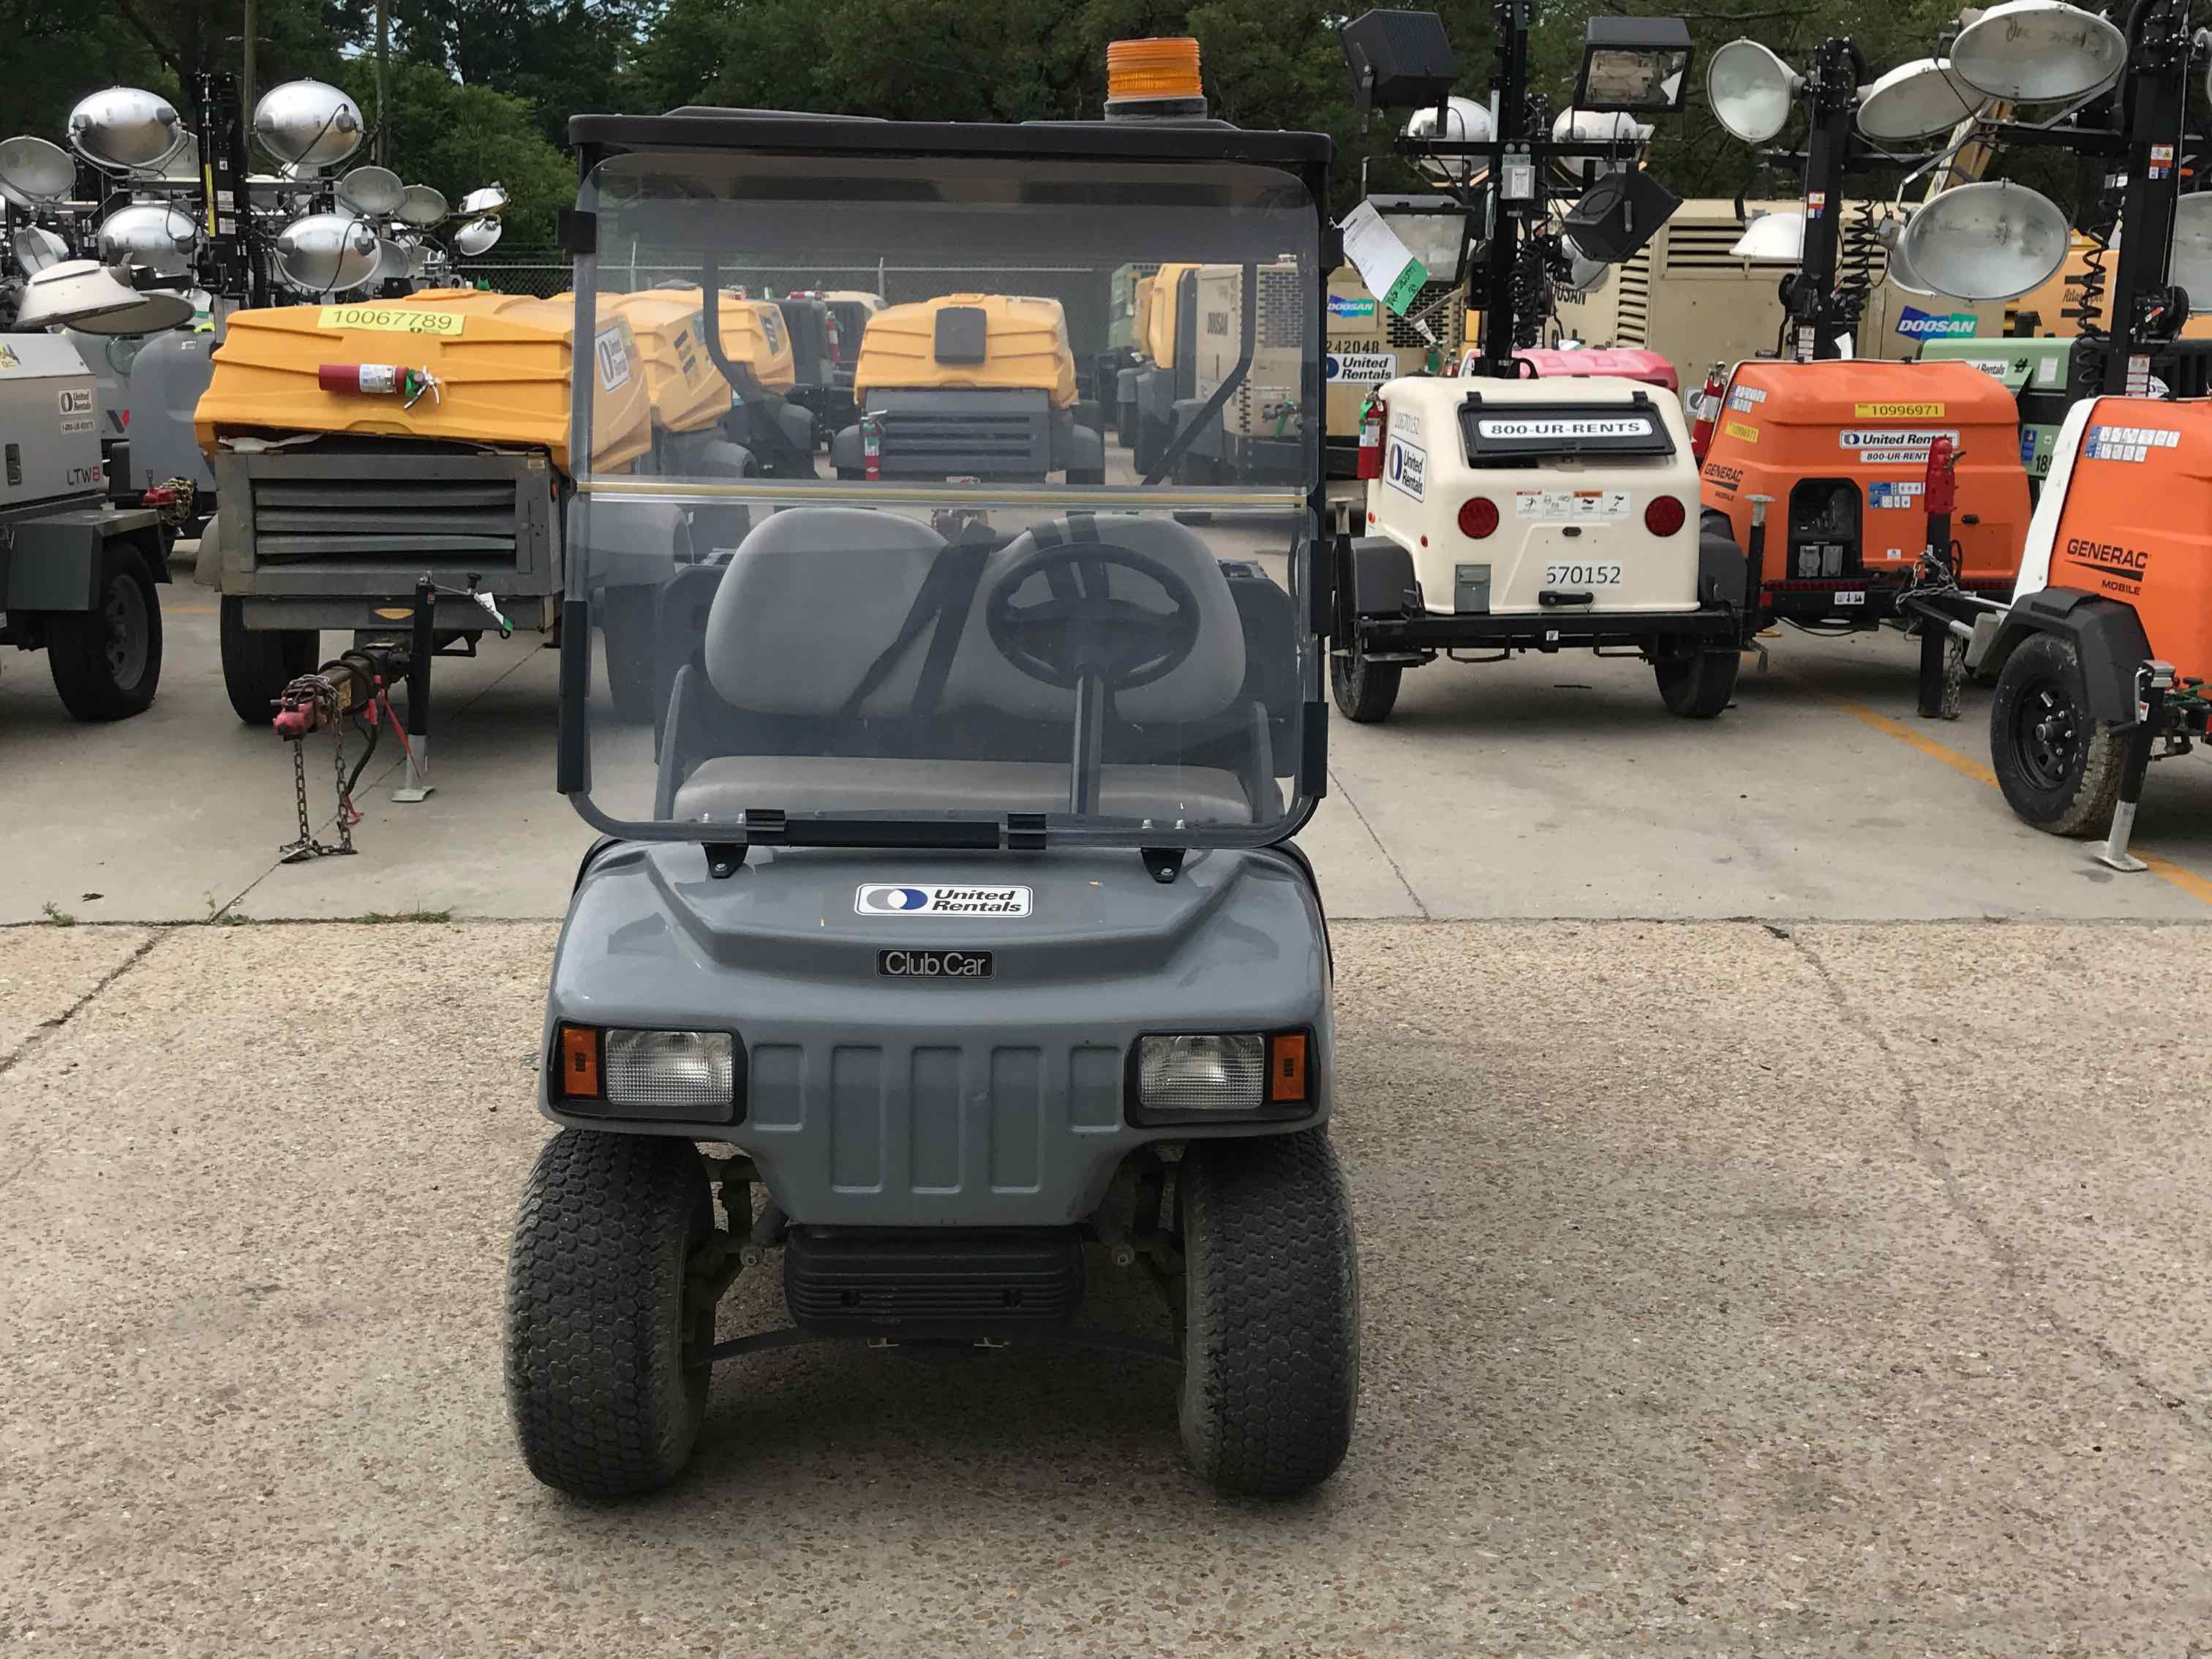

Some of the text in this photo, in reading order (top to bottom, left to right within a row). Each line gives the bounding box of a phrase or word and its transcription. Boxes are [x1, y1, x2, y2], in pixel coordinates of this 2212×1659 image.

[1327, 302, 1374, 311] DOOSAN
[334, 309, 452, 330] 10067789
[1897, 320, 1975, 333] DOOSAN
[1342, 357, 1388, 368] United
[1342, 369, 1391, 380] Rentals
[1982, 364, 2005, 375] Rentals
[1872, 405, 1938, 415] 10996971
[1491, 422, 1640, 434] 800-UR-RENTS
[1862, 434, 1903, 445] United
[1404, 448, 1423, 474] United
[1867, 452, 1928, 461] 800-UR-RENT
[1704, 463, 1744, 483] GENERAC
[1402, 468, 1423, 494] Rentals
[2067, 538, 2148, 568] GENERAC
[2102, 579, 2141, 595] MOBILE
[934, 889, 1015, 900] United
[932, 900, 1022, 912] Rentals
[886, 952, 986, 975] Club Car
